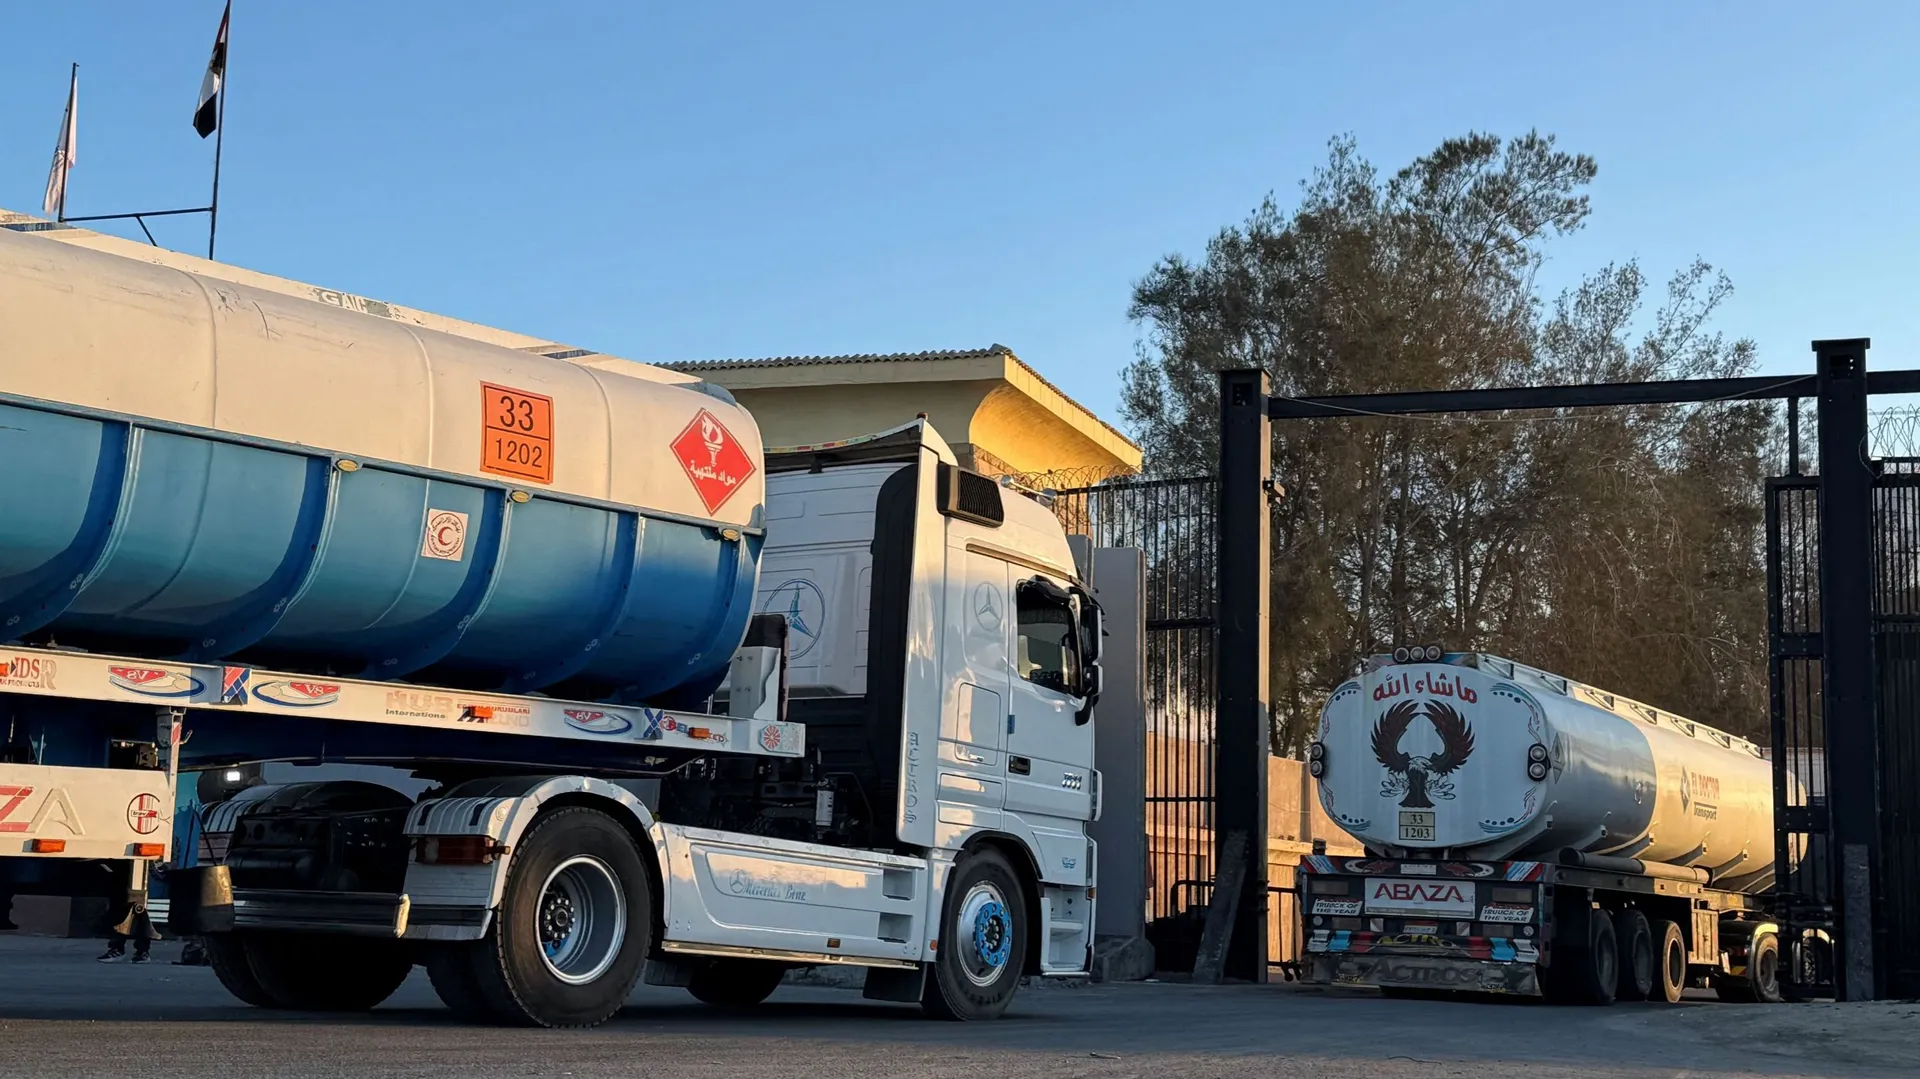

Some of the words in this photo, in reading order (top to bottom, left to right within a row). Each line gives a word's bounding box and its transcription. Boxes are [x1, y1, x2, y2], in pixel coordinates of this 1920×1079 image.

[499, 395, 535, 431] 33
[495, 437, 543, 468] 1202
[1373, 673, 1410, 701] الله
[1410, 813, 1424, 825] 33
[1693, 801, 1718, 820] Transport
[1405, 827, 1430, 838] 1203
[1373, 882, 1465, 903] ABAZA
